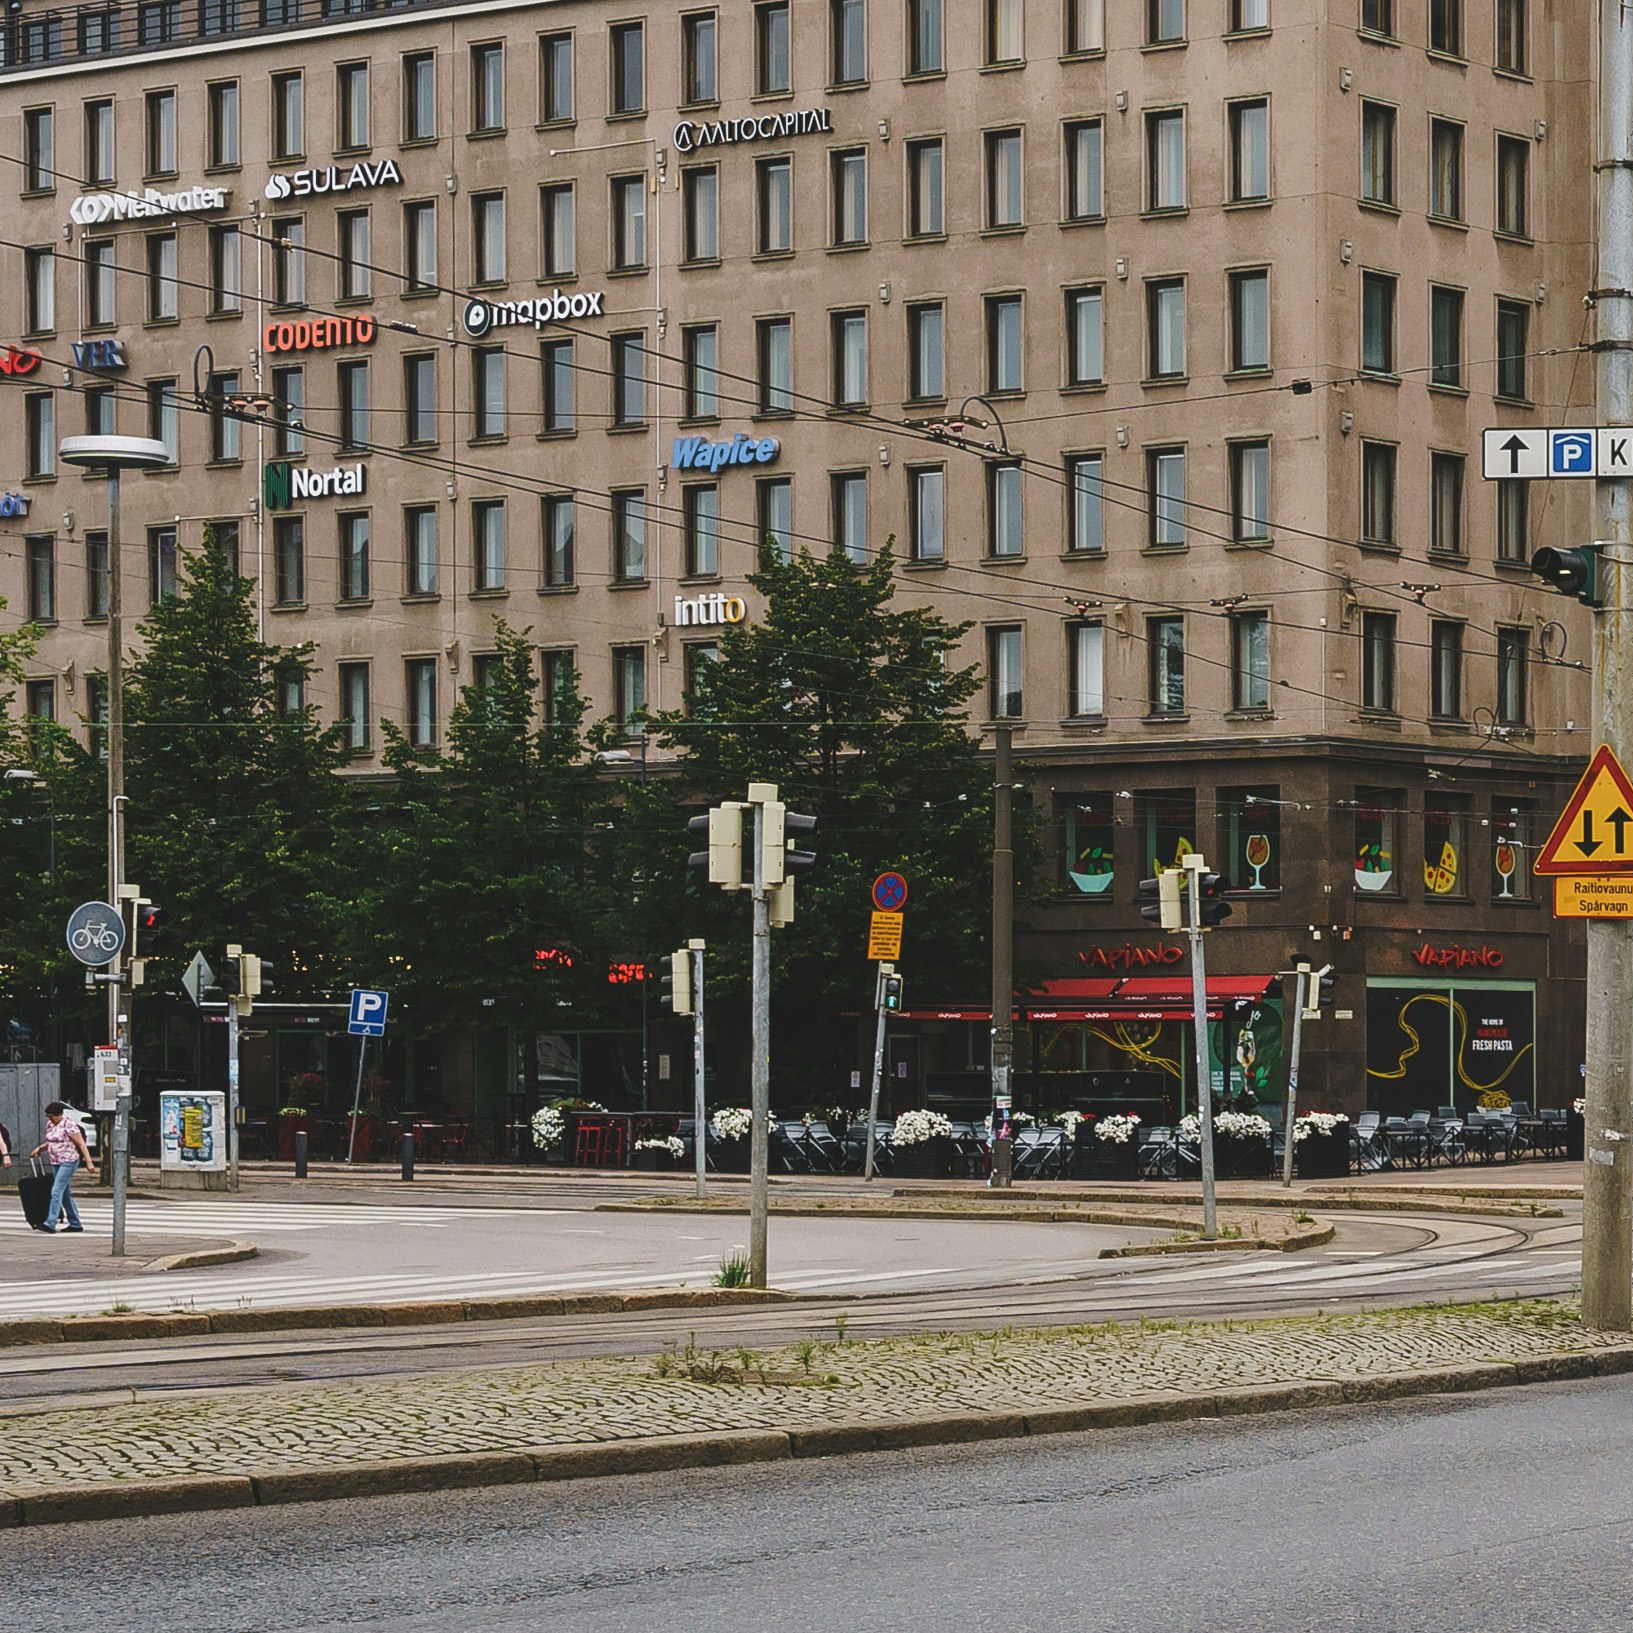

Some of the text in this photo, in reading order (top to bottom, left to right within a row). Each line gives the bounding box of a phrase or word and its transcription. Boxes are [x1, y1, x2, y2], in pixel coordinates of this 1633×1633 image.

[294, 159, 401, 196] SULAVA
[113, 186, 229, 221] Meltwater
[491, 288, 604, 329] mapbox
[672, 433, 777, 473] Wapice
[1562, 444, 1583, 470] P
[291, 463, 364, 499] Nortal
[674, 593, 747, 627] intito
[1574, 881, 1633, 895] Raitiovaunu
[1579, 899, 1629, 914] Spårvagn
[1078, 942, 1183, 969] VAPIANO
[1412, 944, 1504, 969] VAPIANO
[356, 993, 382, 1021] P
[1472, 1039, 1513, 1051] FRESH PASTA
